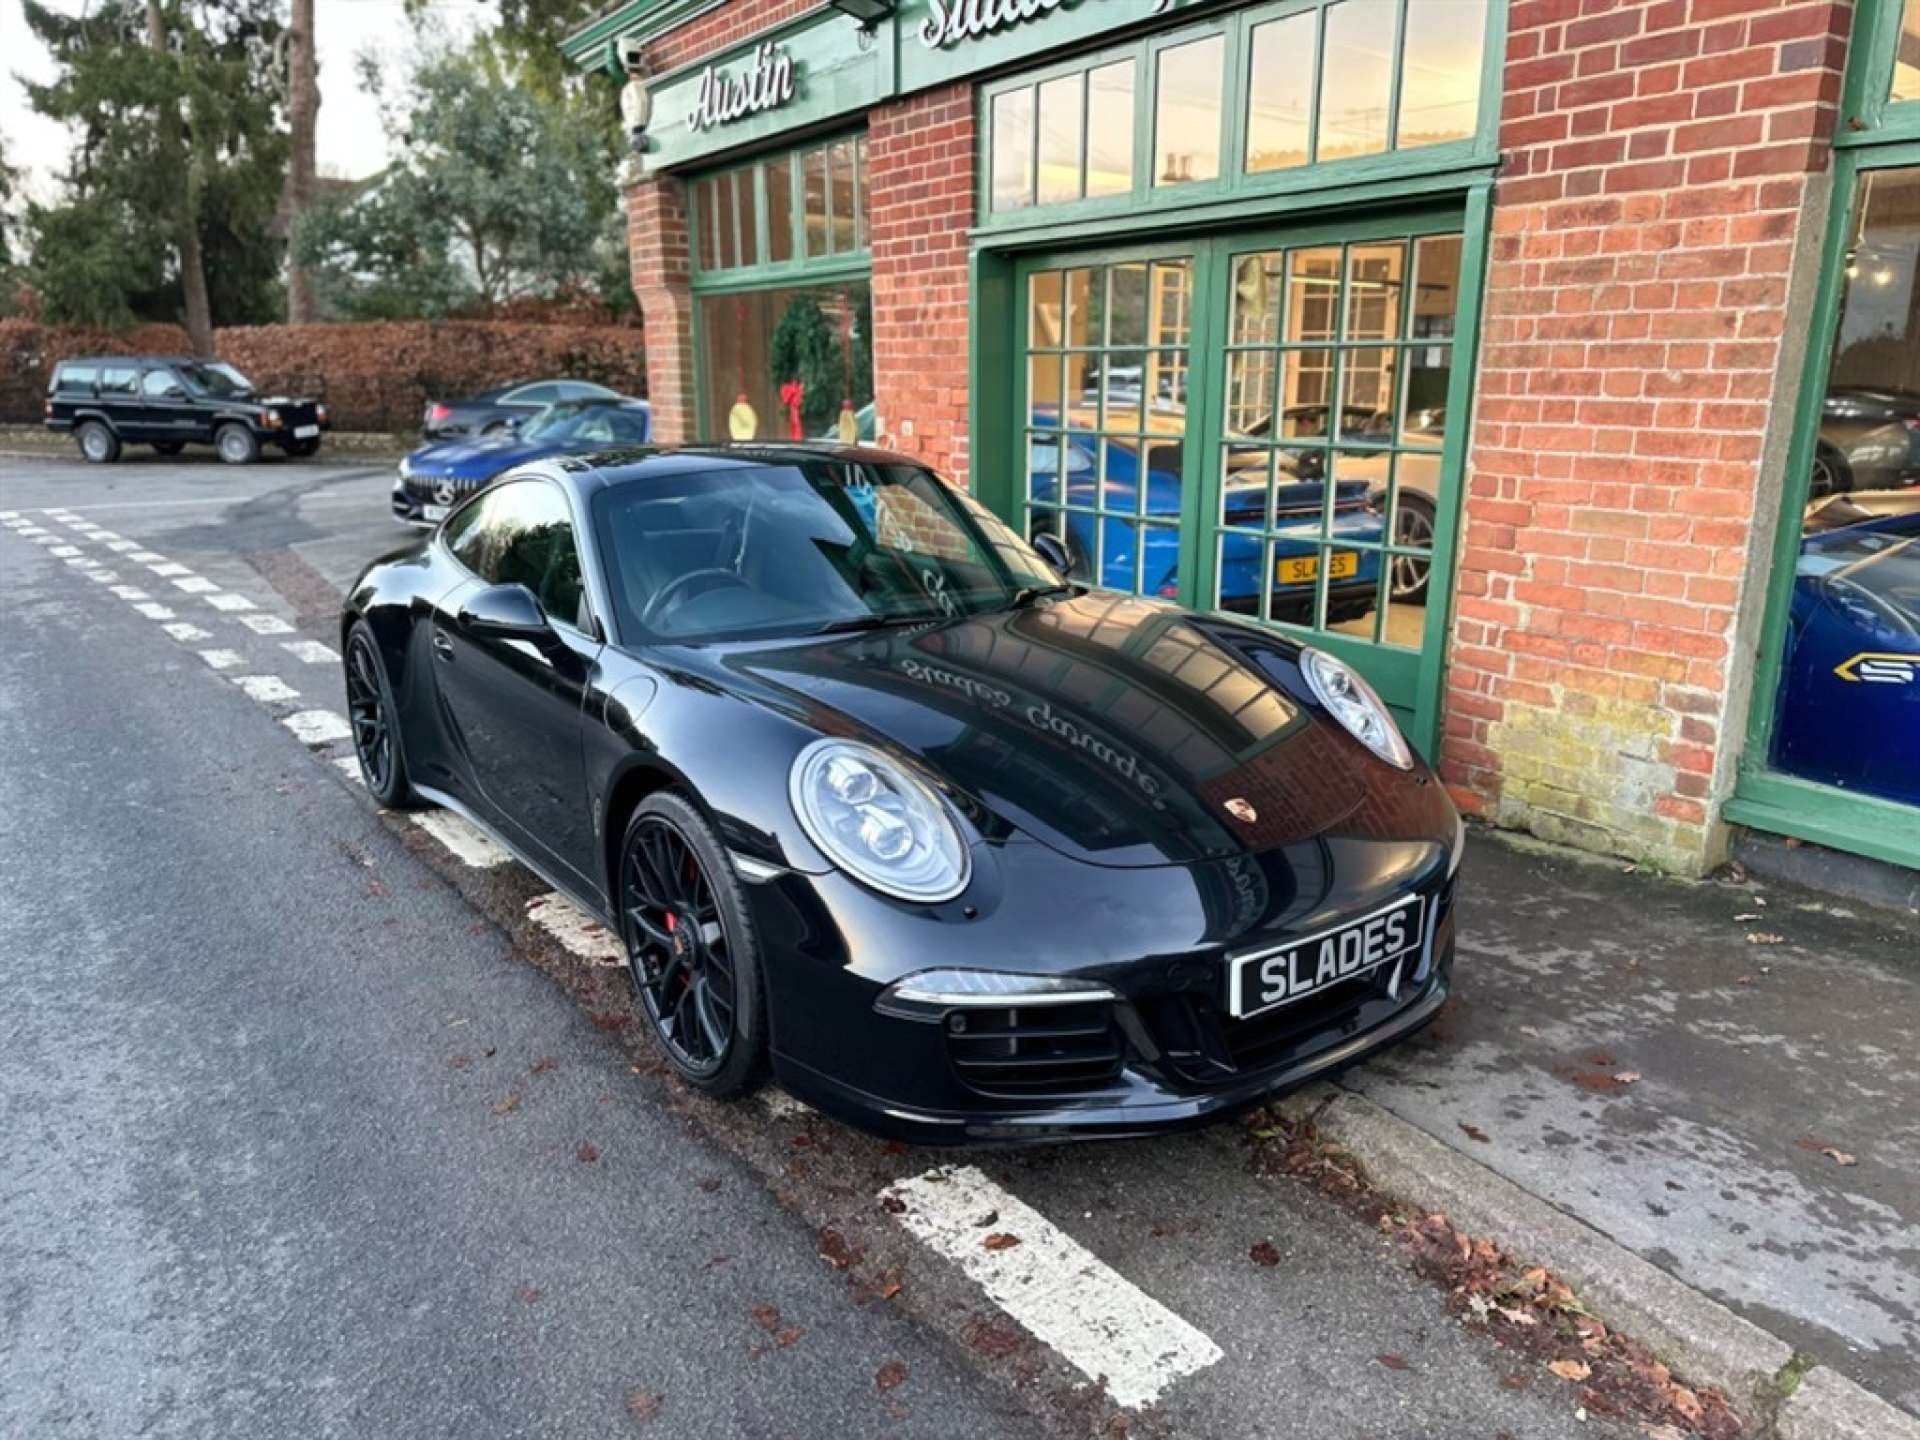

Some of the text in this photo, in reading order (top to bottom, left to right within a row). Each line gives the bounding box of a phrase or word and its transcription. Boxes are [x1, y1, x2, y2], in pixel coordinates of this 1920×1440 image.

[688, 41, 795, 132] Austin
[1292, 556, 1346, 578] SLAES
[1261, 910, 1407, 1002] SLADES
